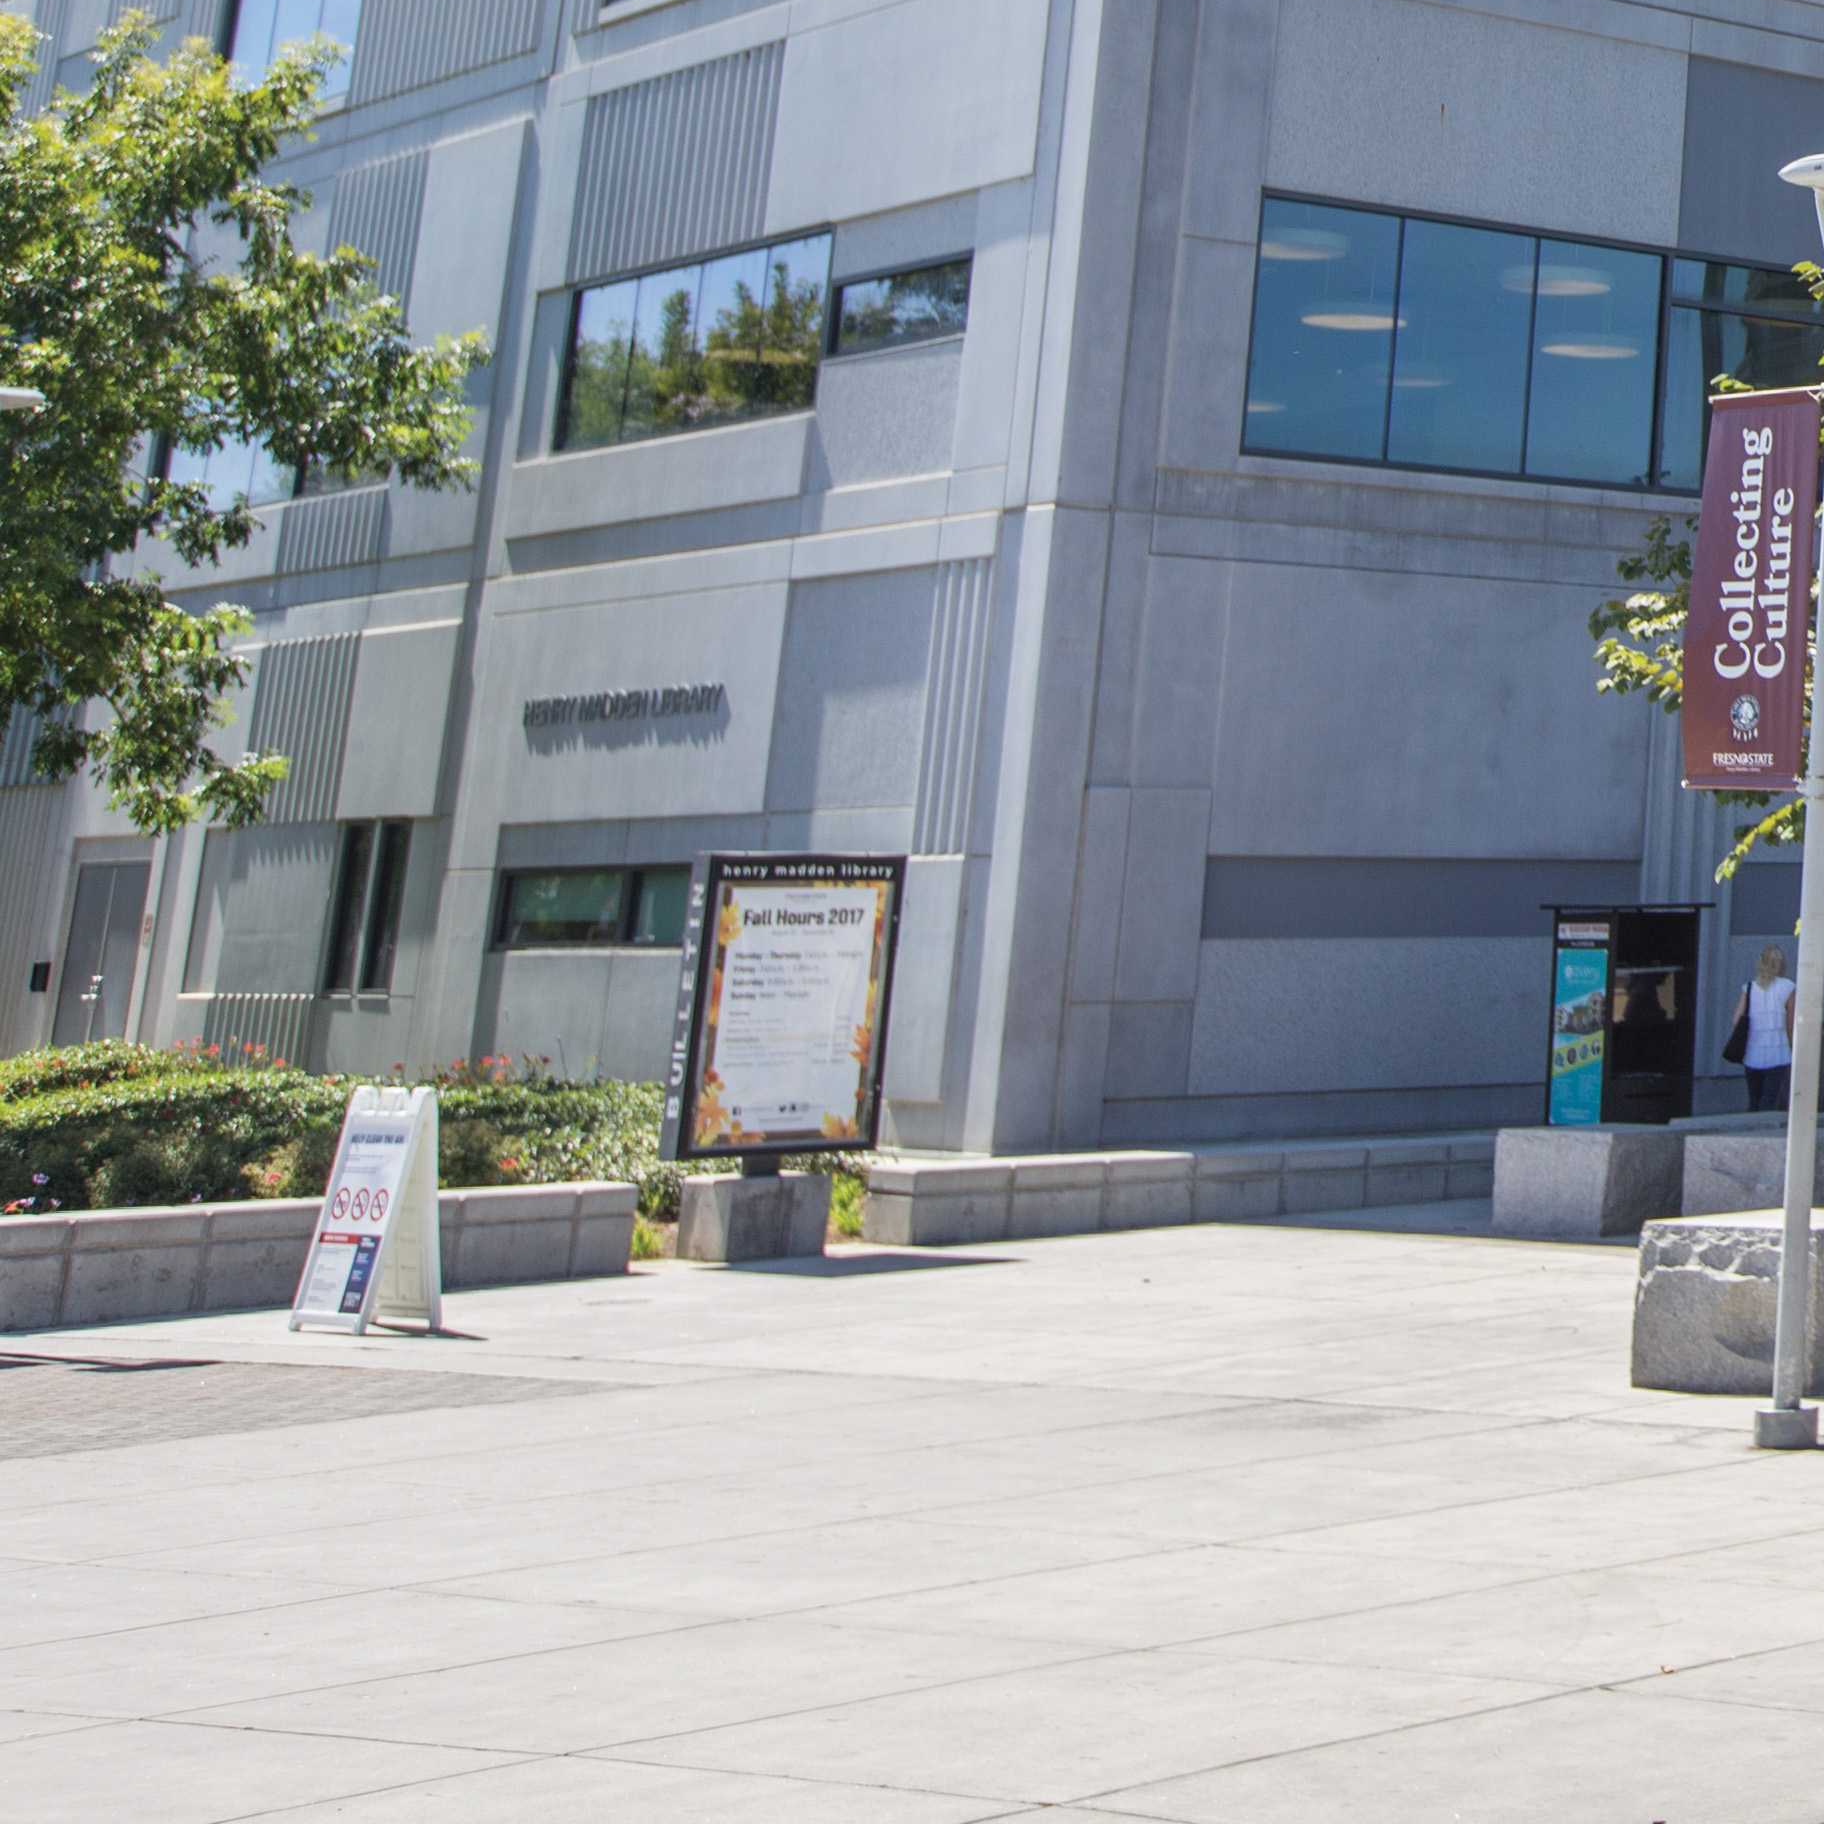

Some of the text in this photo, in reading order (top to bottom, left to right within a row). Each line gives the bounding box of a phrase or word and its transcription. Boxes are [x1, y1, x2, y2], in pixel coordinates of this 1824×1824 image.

[1713, 426, 1773, 679] Collecting
[1753, 487, 1794, 679] Culture
[524, 683, 724, 727] HENRY MADDEN LIBRARY
[723, 863, 894, 880] henry madden library
[743, 906, 866, 926] Fall Hours 2017
[667, 882, 705, 1120] BULLETIN
